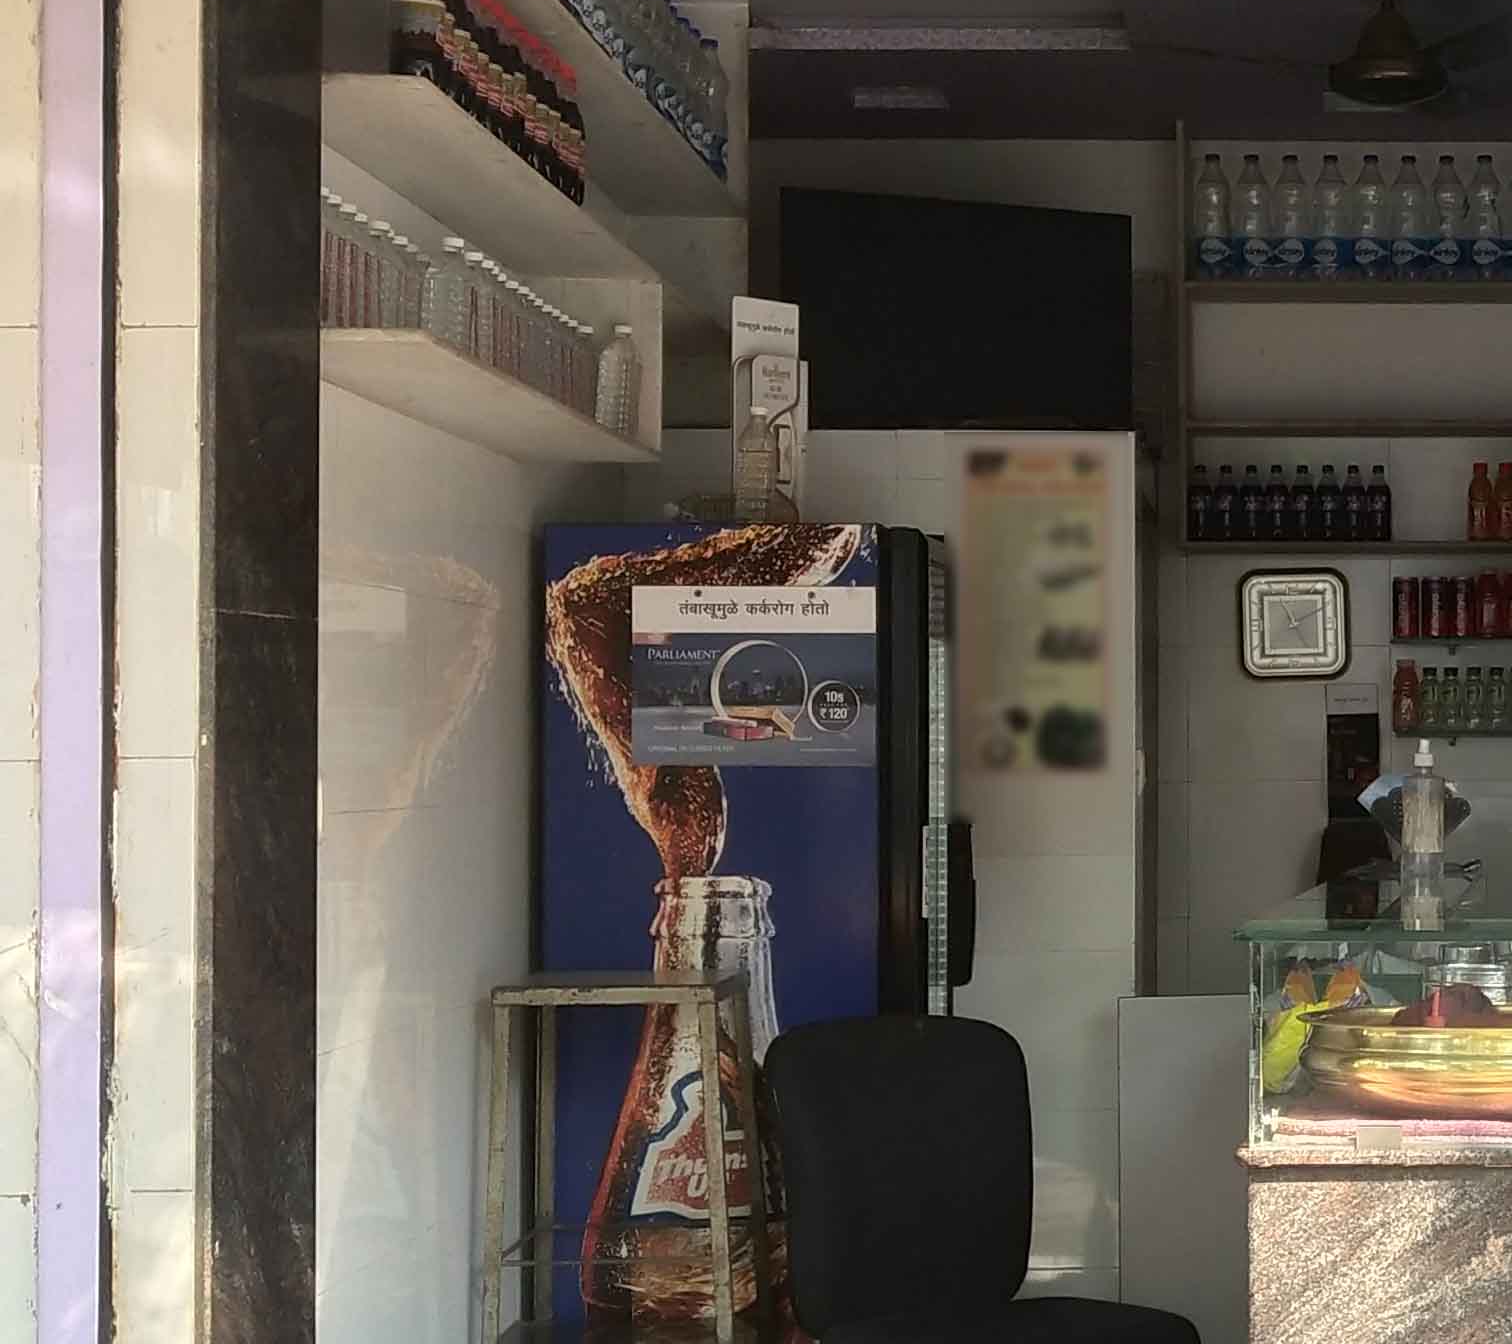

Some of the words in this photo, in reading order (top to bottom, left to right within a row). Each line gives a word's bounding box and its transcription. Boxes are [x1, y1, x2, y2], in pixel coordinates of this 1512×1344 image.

[678, 599, 738, 620] तंबाखूमुळे
[745, 598, 794, 616] कर्करोग
[801, 599, 830, 616] होतो
[824, 690, 844, 703] 10s
